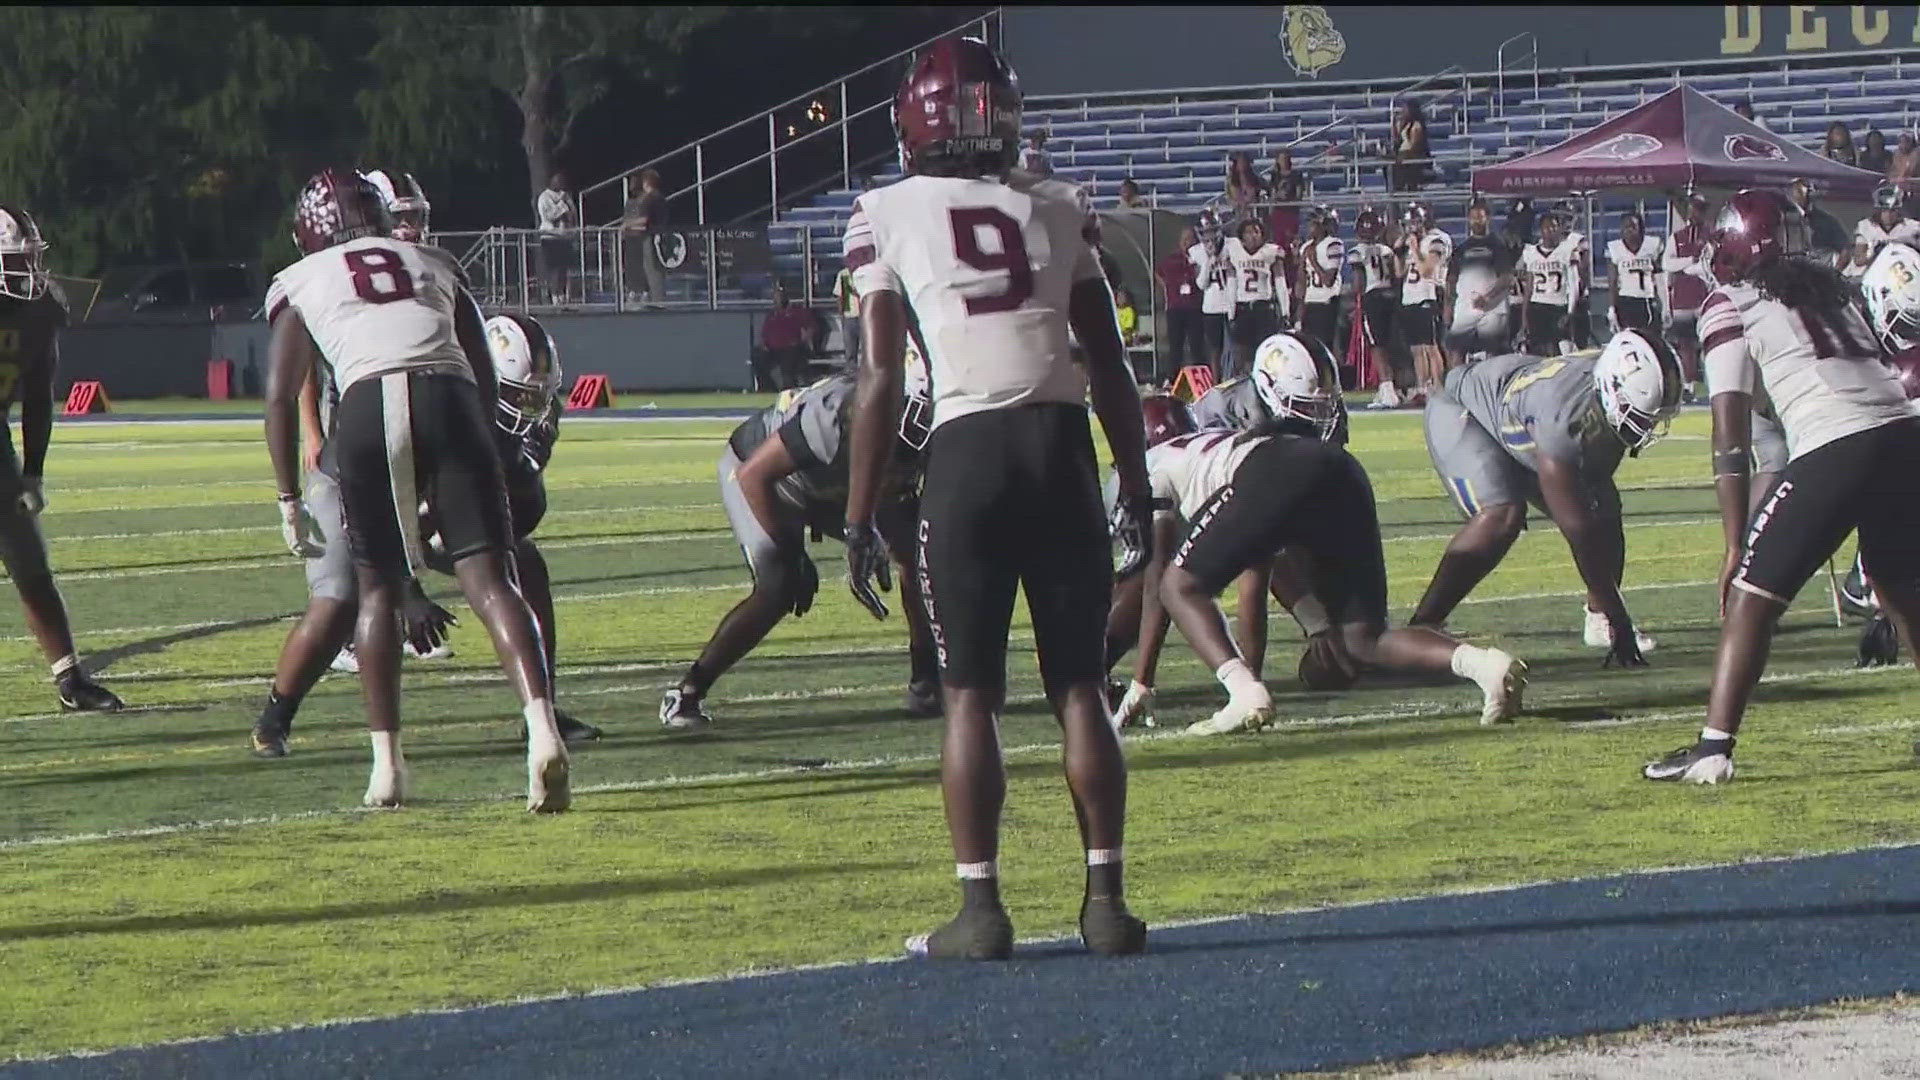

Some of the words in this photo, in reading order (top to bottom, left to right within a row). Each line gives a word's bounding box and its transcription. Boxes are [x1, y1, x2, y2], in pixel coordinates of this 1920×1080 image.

[1720, 5, 1920, 54] DEC
[344, 247, 415, 304] 8
[948, 207, 1035, 316] 9
[1243, 269, 1259, 292] 2
[1533, 271, 1562, 292] 27
[1629, 268, 1645, 290] 7
[67, 384, 92, 412] 30
[570, 378, 597, 407] 40
[918, 518, 947, 669] CARVER
